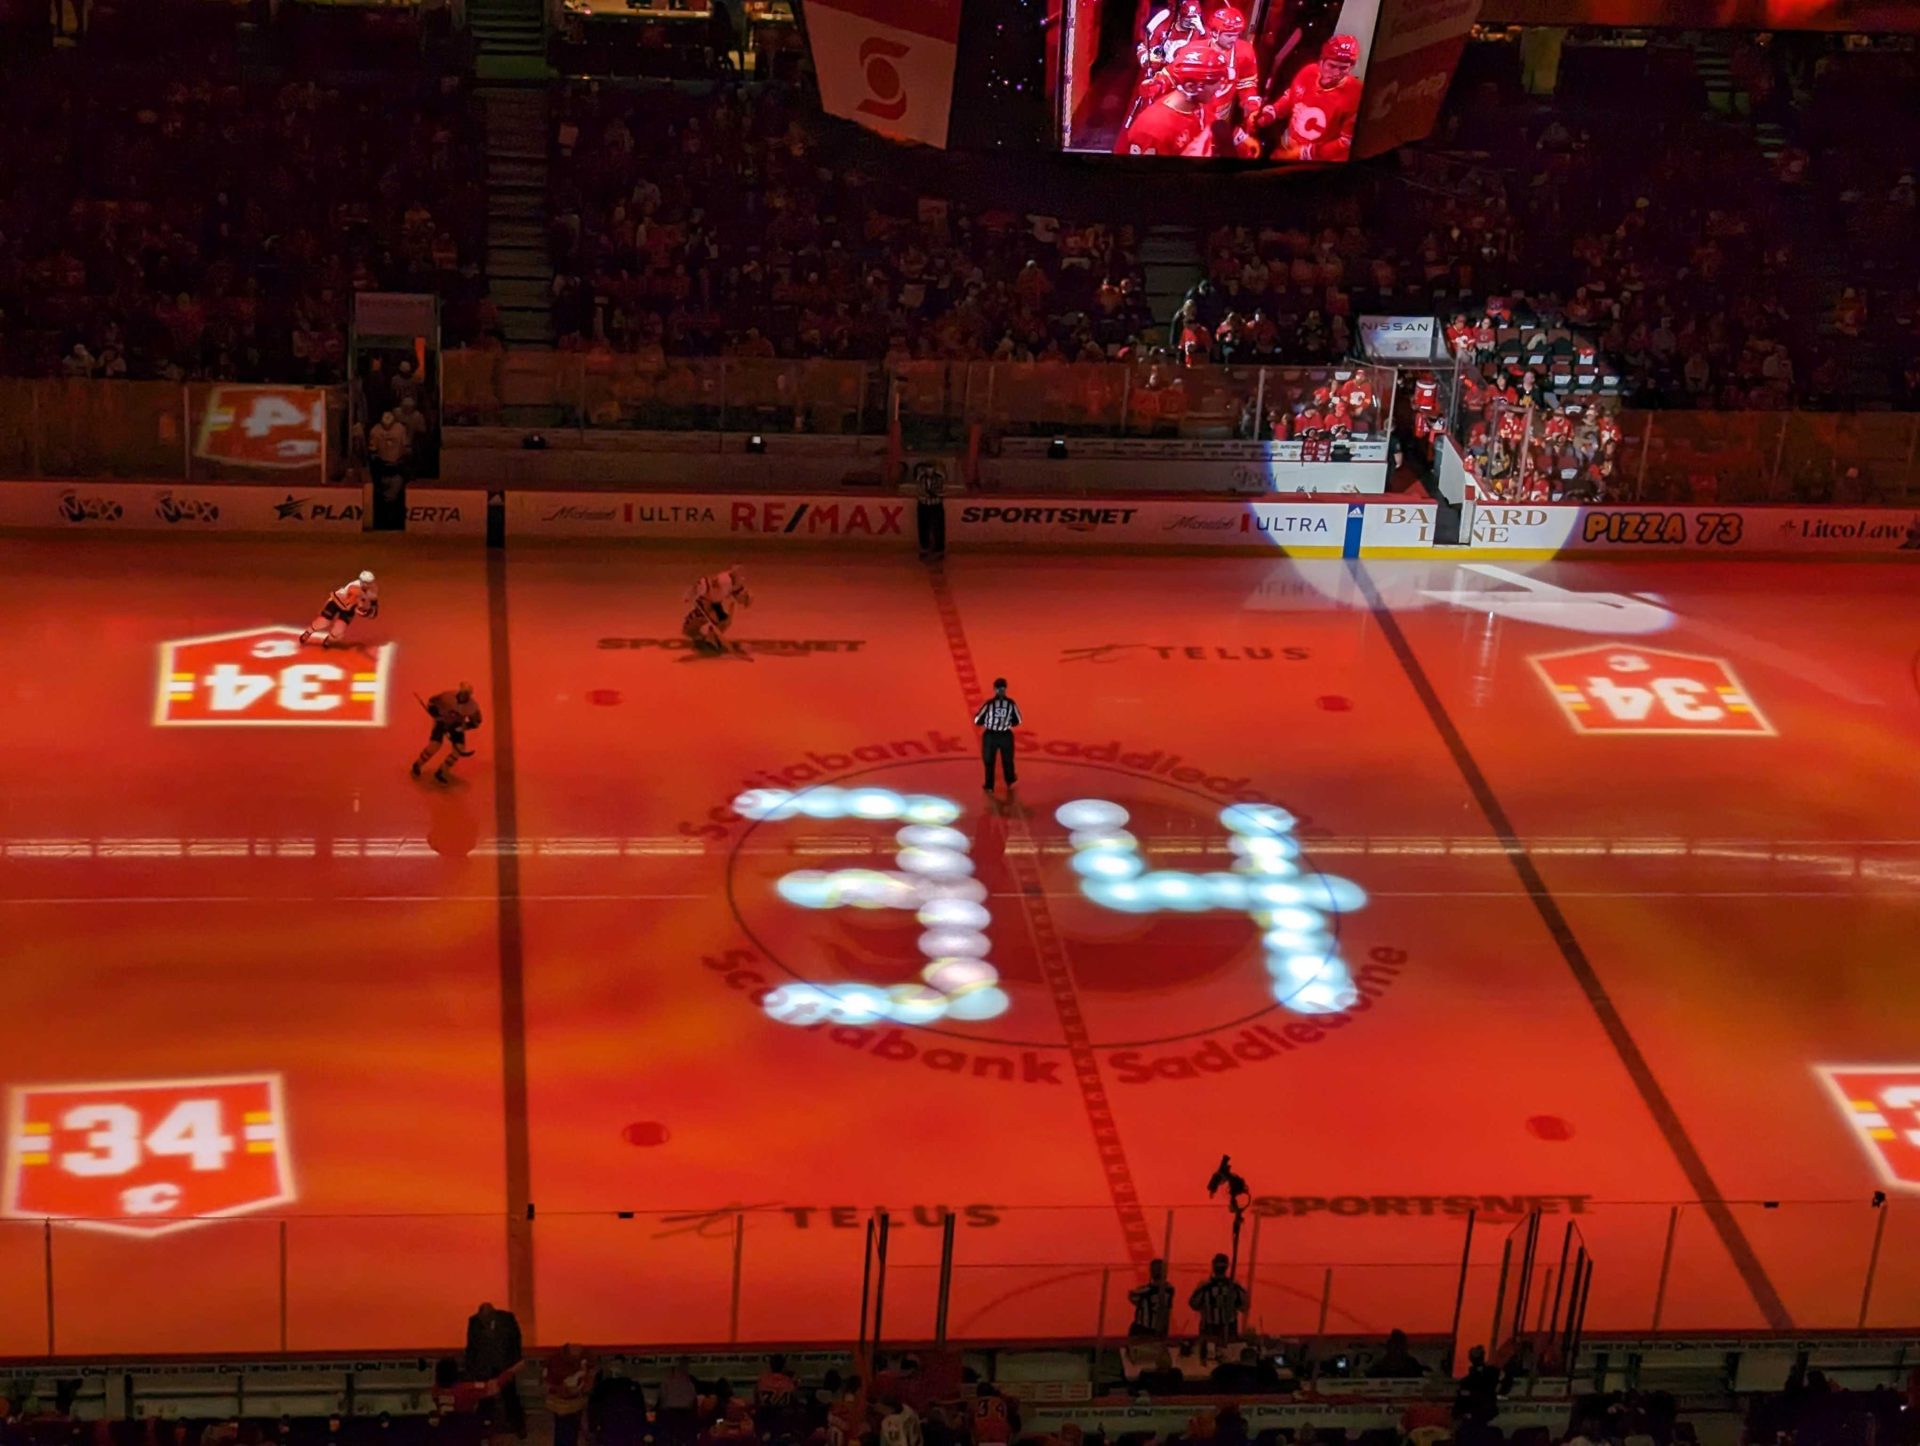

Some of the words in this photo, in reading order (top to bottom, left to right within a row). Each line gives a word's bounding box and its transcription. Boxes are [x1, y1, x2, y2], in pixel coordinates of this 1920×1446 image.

[1360, 322, 1429, 332] NISSAN
[638, 506, 716, 522] ULTRA
[730, 501, 904, 535] RE/MAX
[960, 506, 1138, 526] SPORTSNET
[1256, 516, 1328, 532] ULTRA
[1384, 507, 1548, 526] BAARD
[1583, 511, 1686, 544] PIZZA
[1696, 512, 1743, 545] 73
[1418, 526, 1510, 543] LNE
[1151, 646, 1313, 661] TELUS
[203, 663, 347, 712] 34
[1584, 676, 1725, 721] 34
[733, 786, 1367, 1027] 34
[60, 1097, 236, 1178] 34
[783, 1204, 1007, 1228] TELUS
[1252, 1194, 1593, 1218] SPORTSNET
